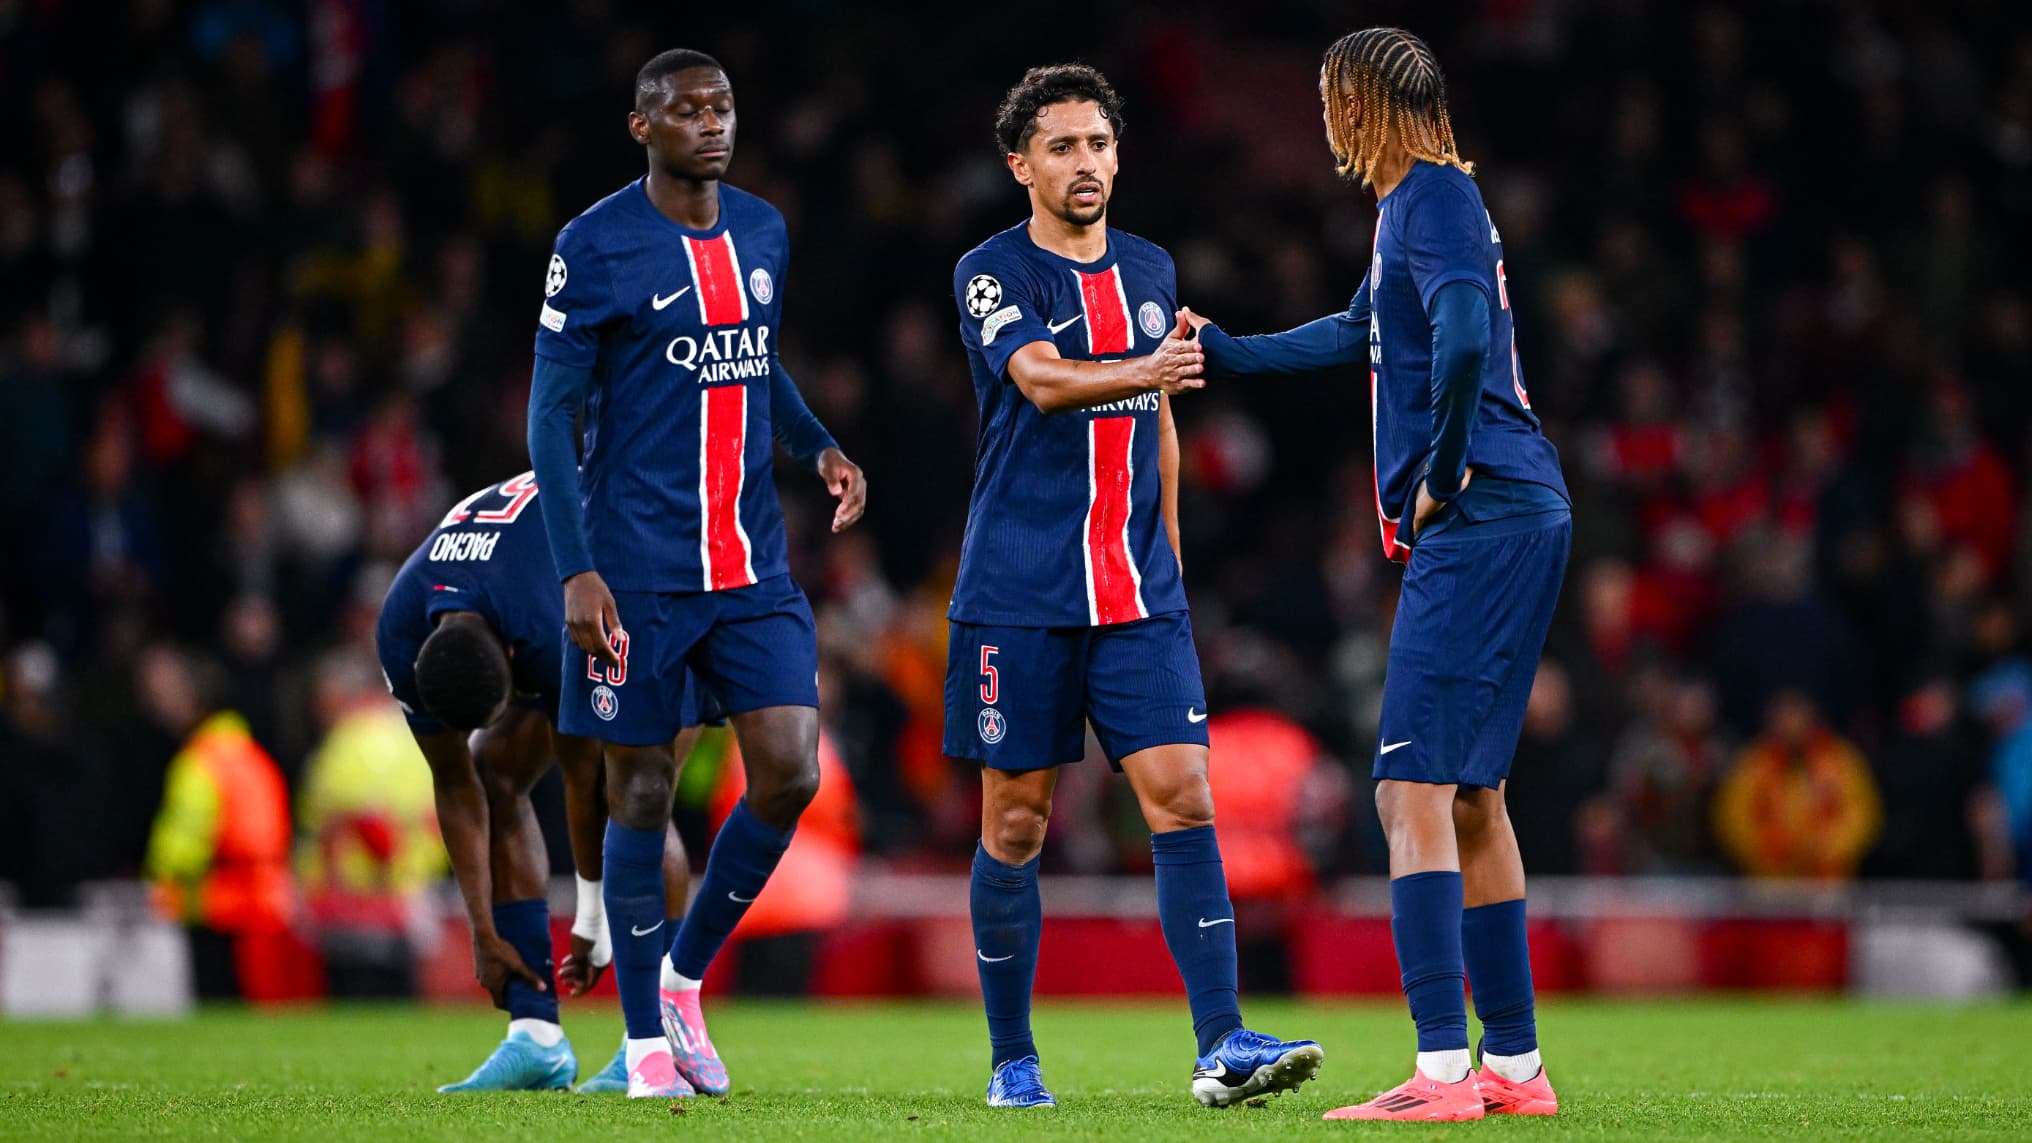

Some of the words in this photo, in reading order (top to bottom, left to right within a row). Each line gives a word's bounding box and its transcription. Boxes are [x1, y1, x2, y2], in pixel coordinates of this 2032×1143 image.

[665, 325, 769, 371] QATAR
[698, 357, 769, 383] AIRWAYS
[1081, 392, 1159, 412] WAYS
[428, 531, 501, 562] PACHO
[980, 645, 999, 705] 5
